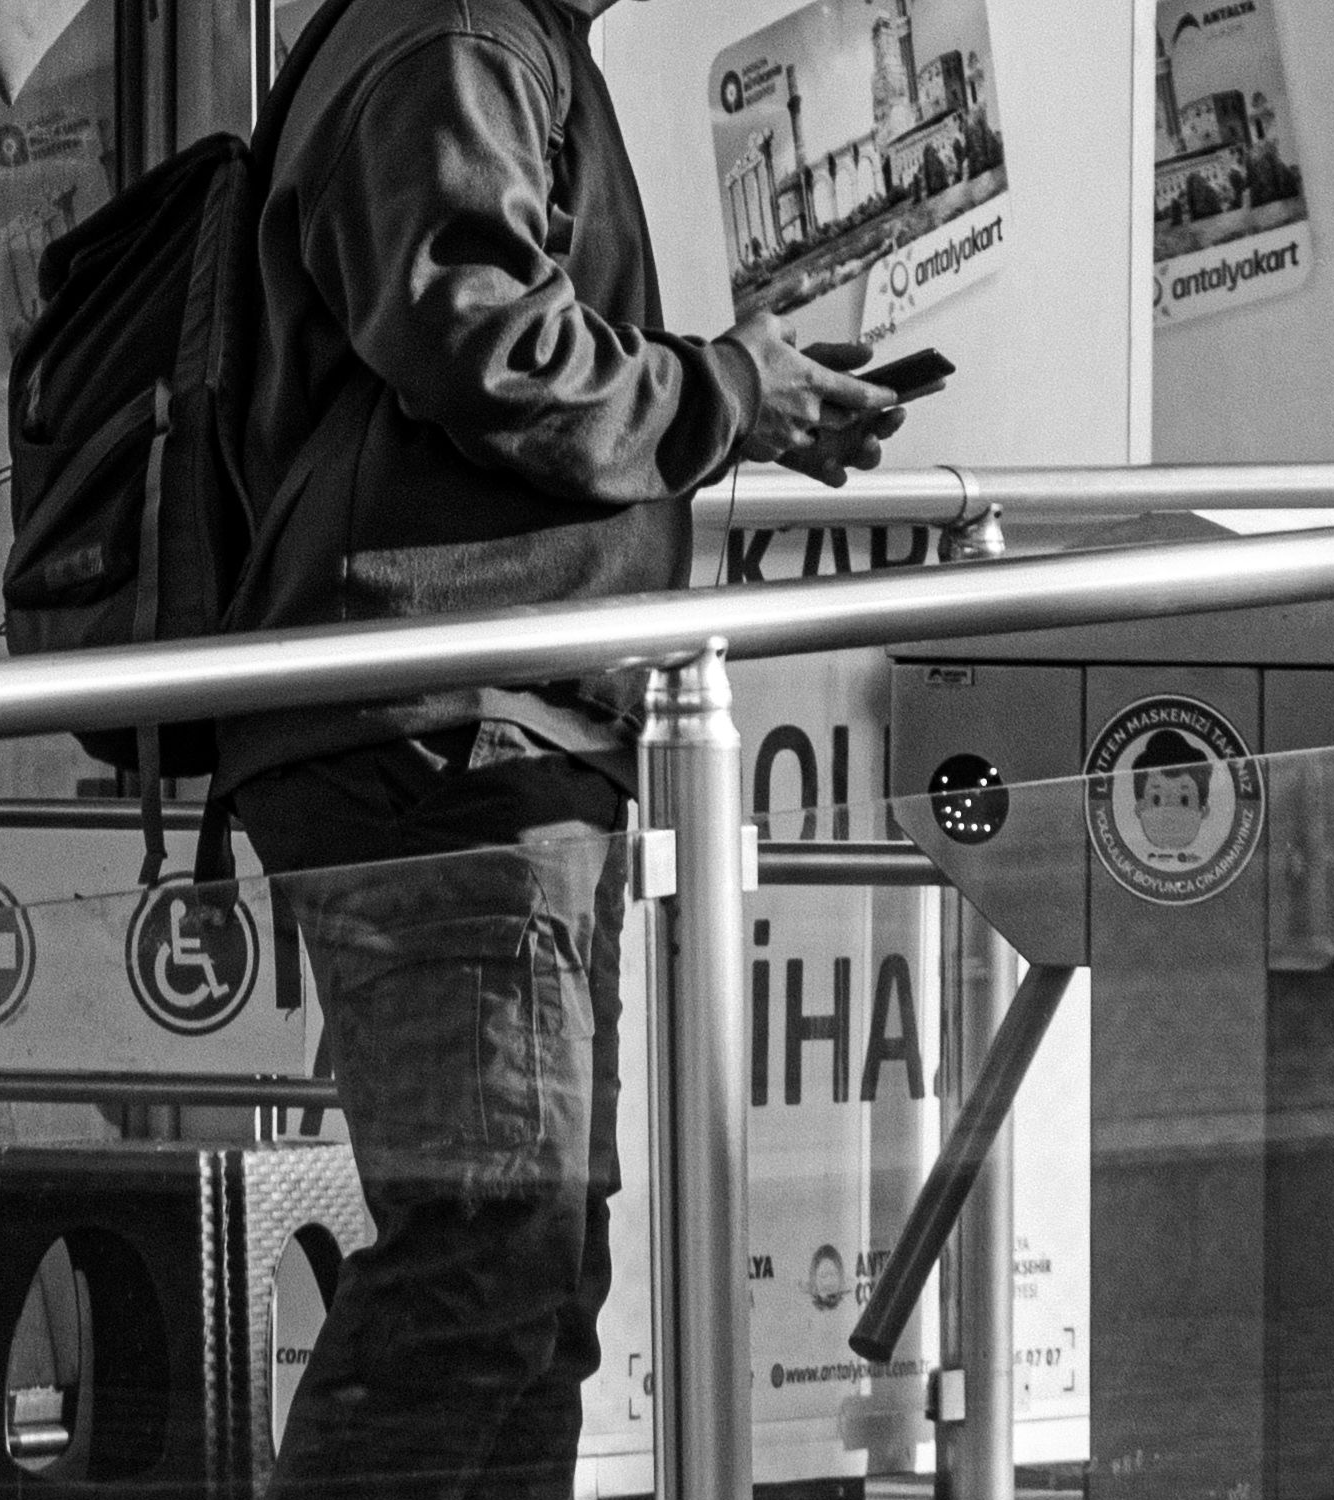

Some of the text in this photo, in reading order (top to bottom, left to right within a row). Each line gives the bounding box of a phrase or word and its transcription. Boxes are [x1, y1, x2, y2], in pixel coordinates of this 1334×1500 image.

[914, 215, 1004, 288] antalyakart
[1170, 240, 1301, 301] antalyakart
[1124, 707, 1213, 736] MASKENİZİ
